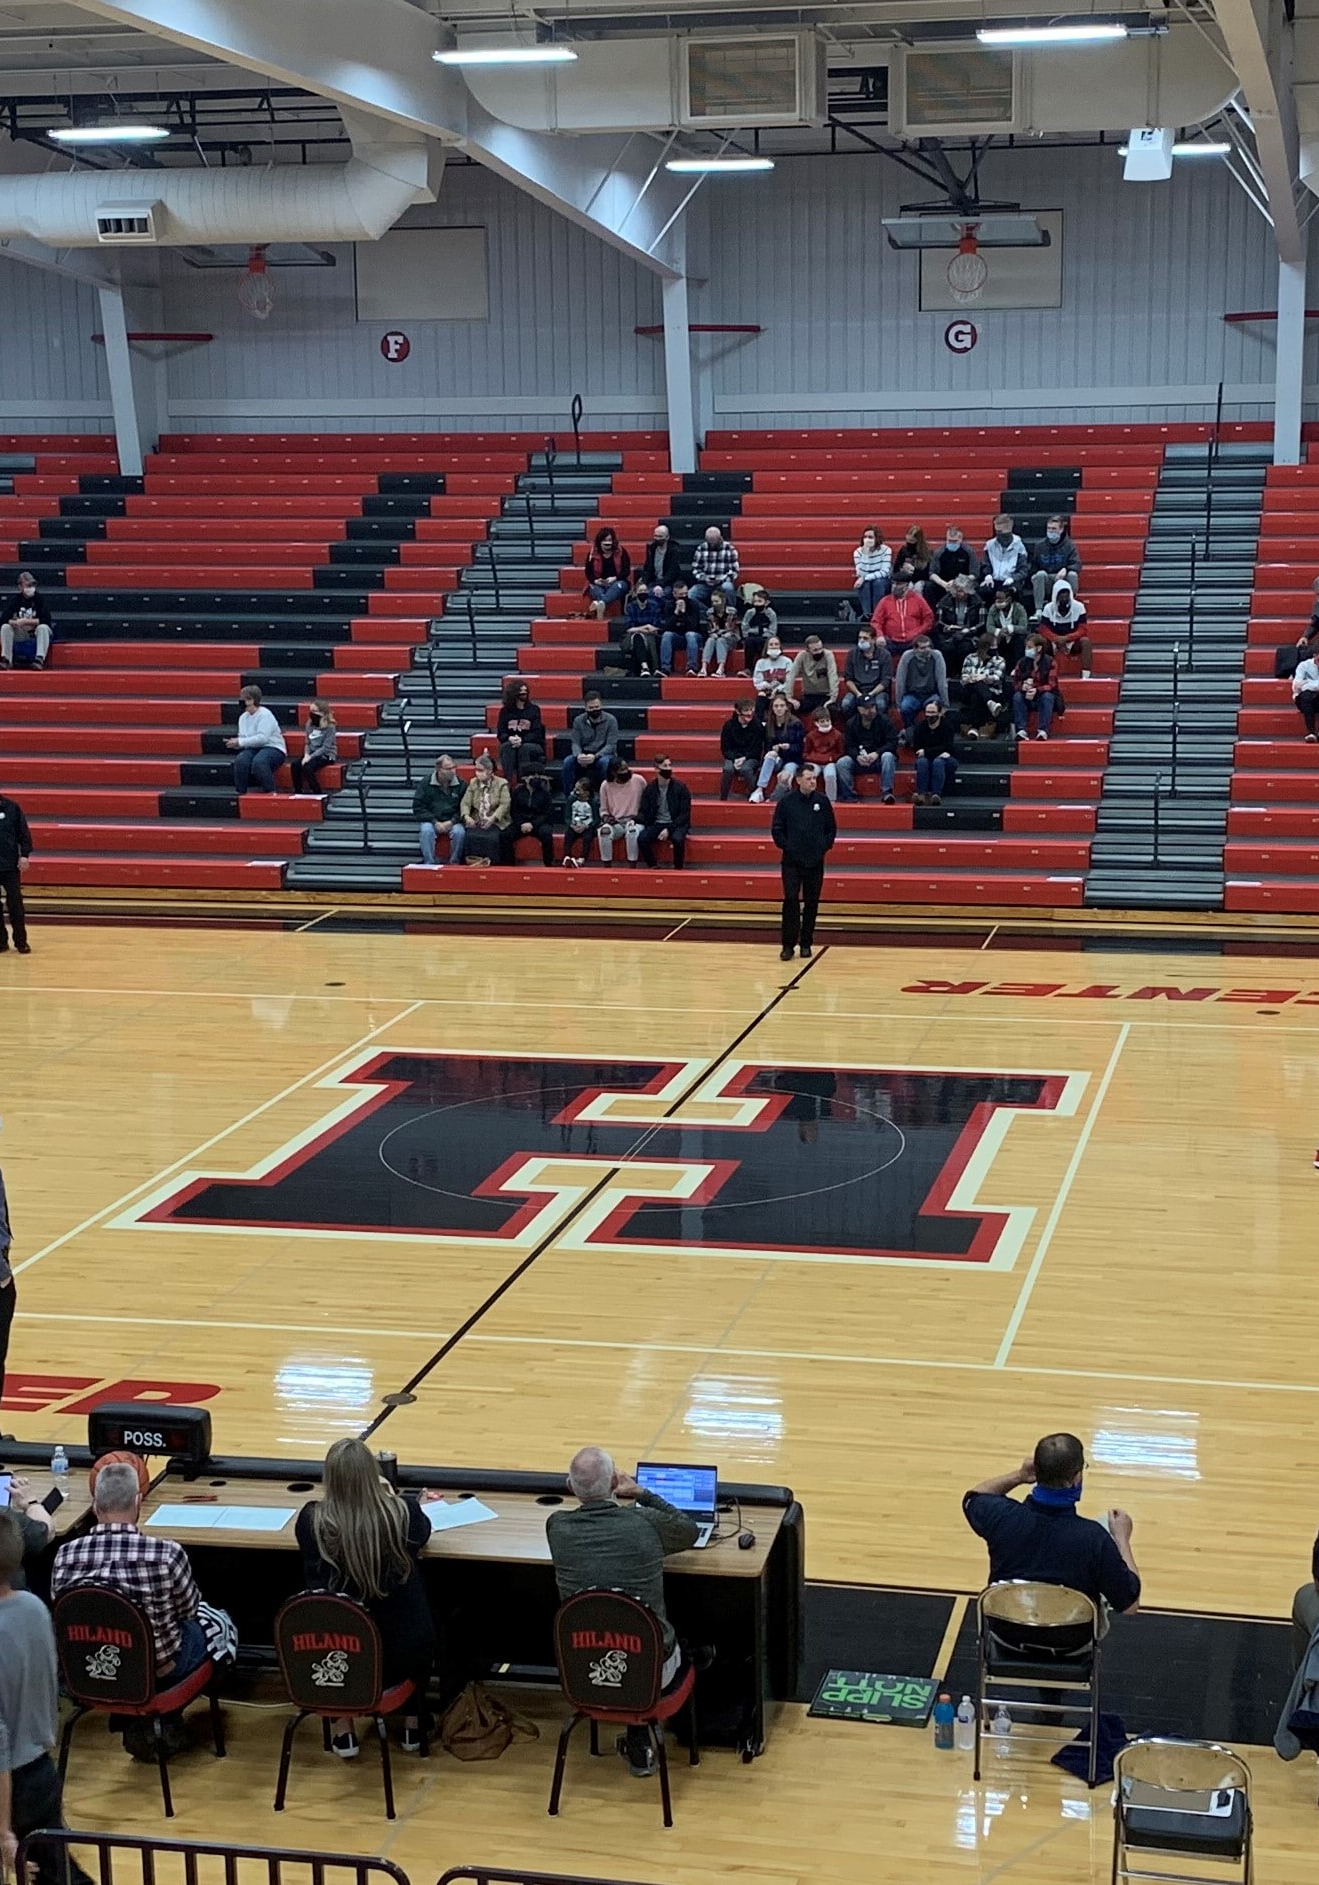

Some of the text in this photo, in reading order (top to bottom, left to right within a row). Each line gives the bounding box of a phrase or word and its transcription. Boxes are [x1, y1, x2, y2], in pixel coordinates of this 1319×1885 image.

[386, 335, 404, 359] F
[947, 324, 972, 350] G
[109, 1046, 1093, 1273] H
[123, 1430, 167, 1447] POSS.
[66, 1624, 133, 1648] HILAND
[293, 1631, 361, 1653] HILAND
[571, 1630, 642, 1655] HILAND
[821, 1688, 928, 1709] SLIPP
